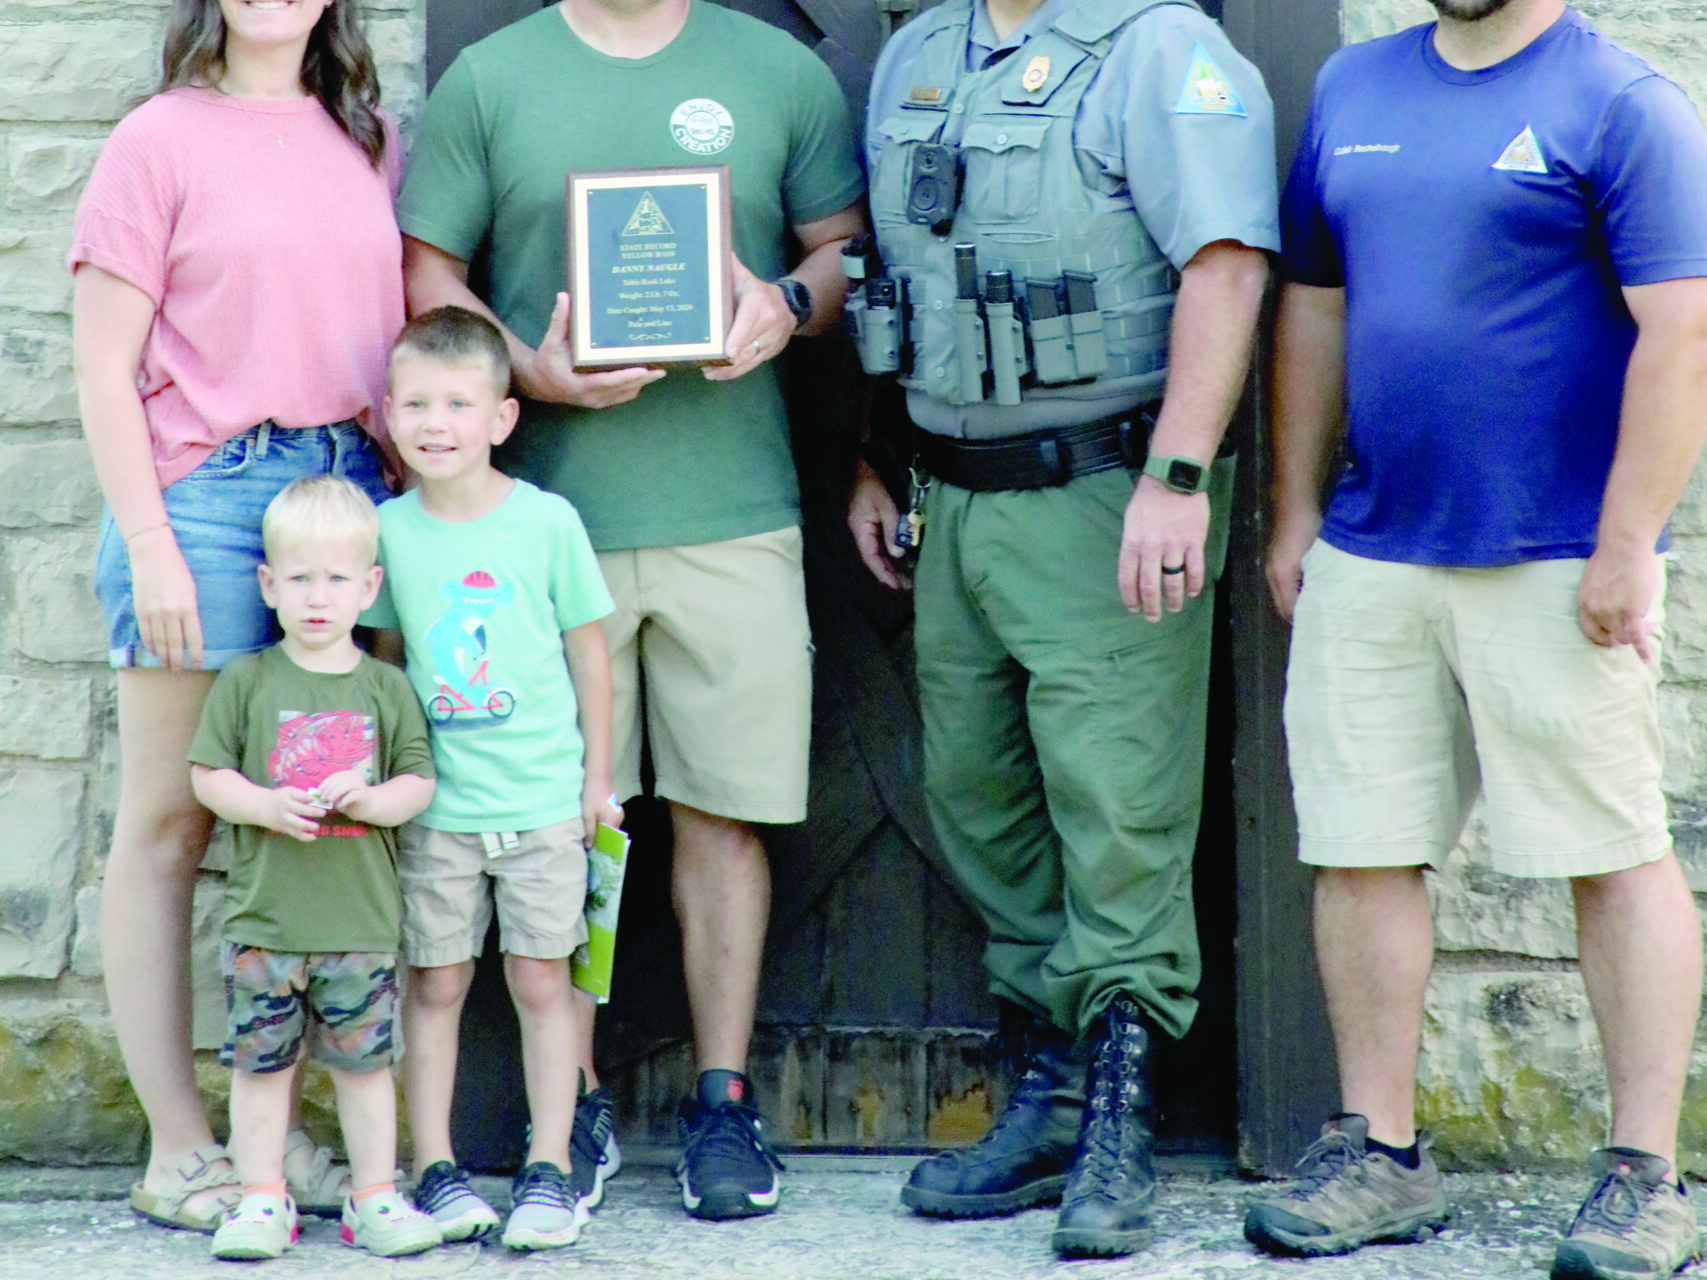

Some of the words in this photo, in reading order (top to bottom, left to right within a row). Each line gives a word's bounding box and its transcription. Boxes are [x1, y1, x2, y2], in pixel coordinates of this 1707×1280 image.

[675, 127, 731, 153] CREATION
[644, 242, 677, 250] RECORD
[621, 251, 653, 259] YELLOW
[655, 250, 676, 258] BASS
[611, 264, 644, 274] DANNY
